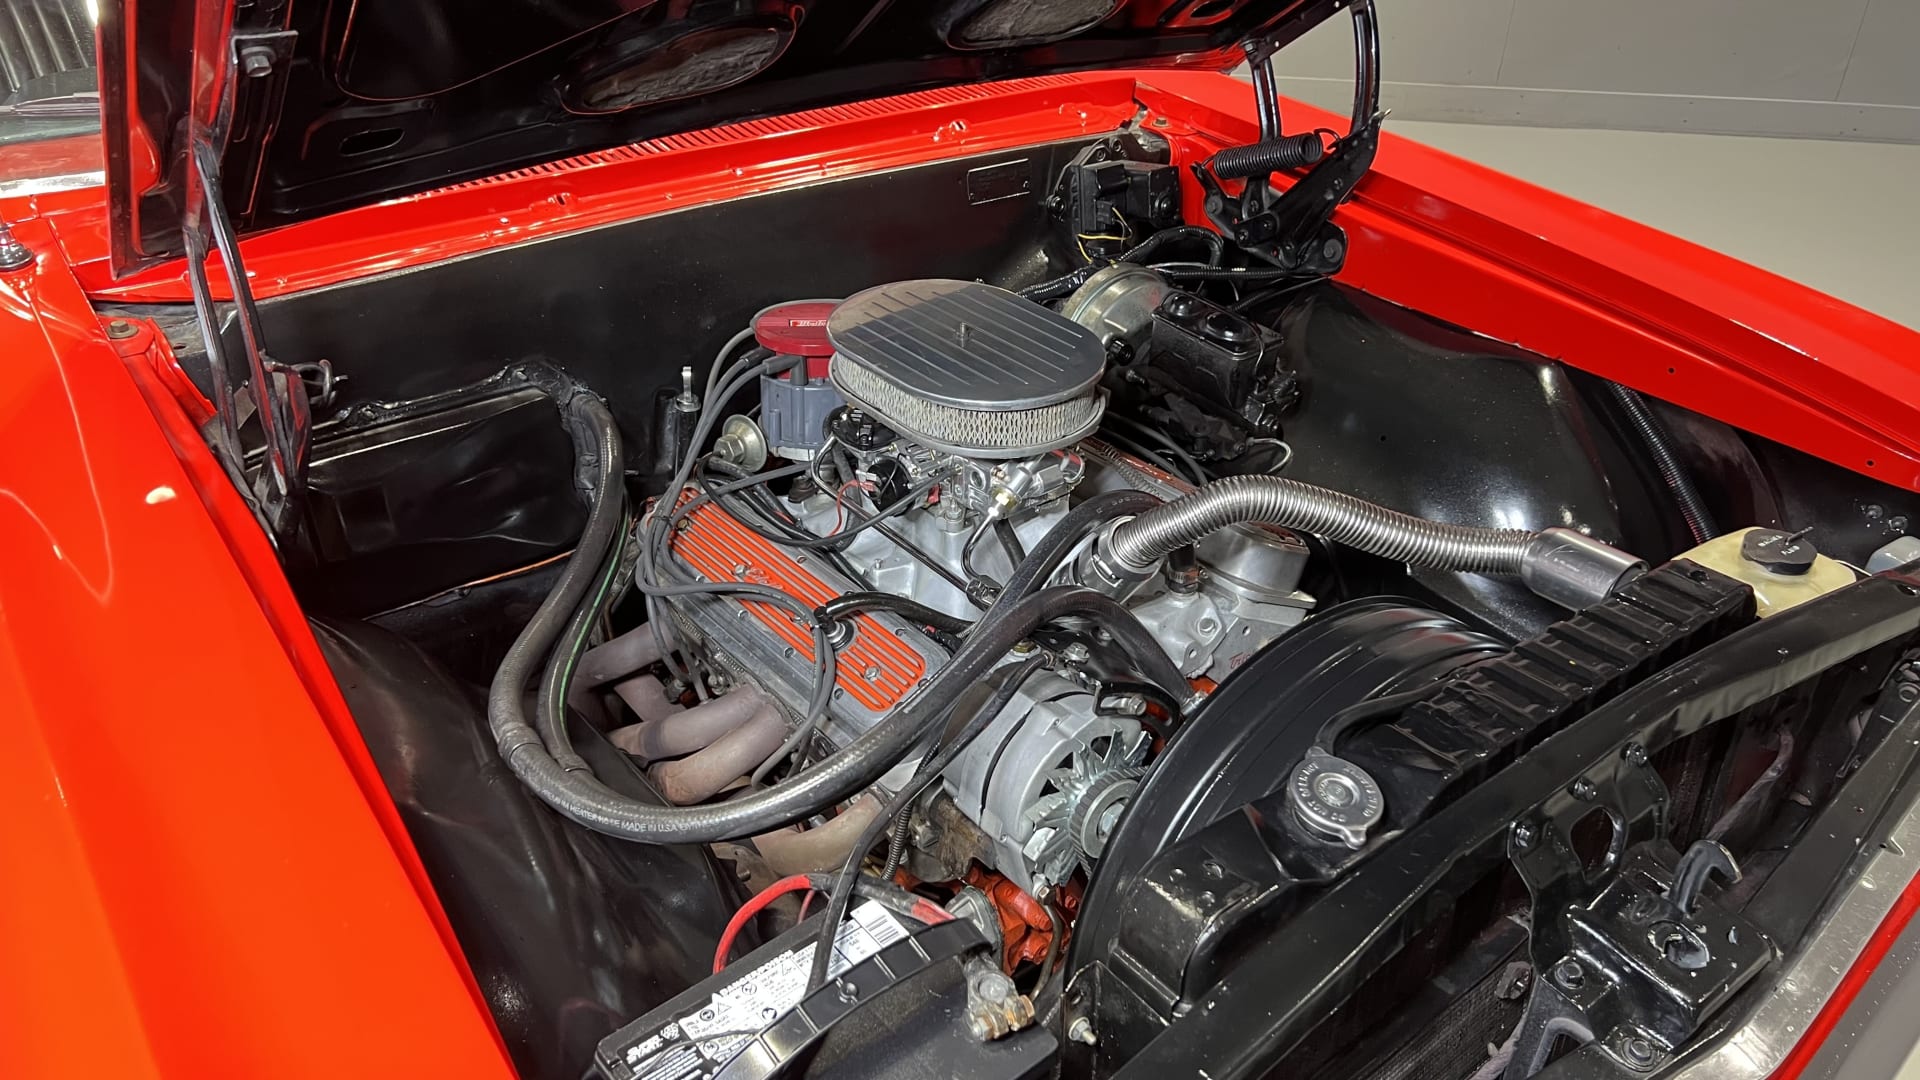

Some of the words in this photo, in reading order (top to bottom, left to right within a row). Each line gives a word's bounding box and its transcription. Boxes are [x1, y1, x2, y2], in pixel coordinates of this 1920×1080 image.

[569, 804, 598, 823] HEATER
[621, 820, 647, 832] MADE
[647, 823, 657, 832] IN
